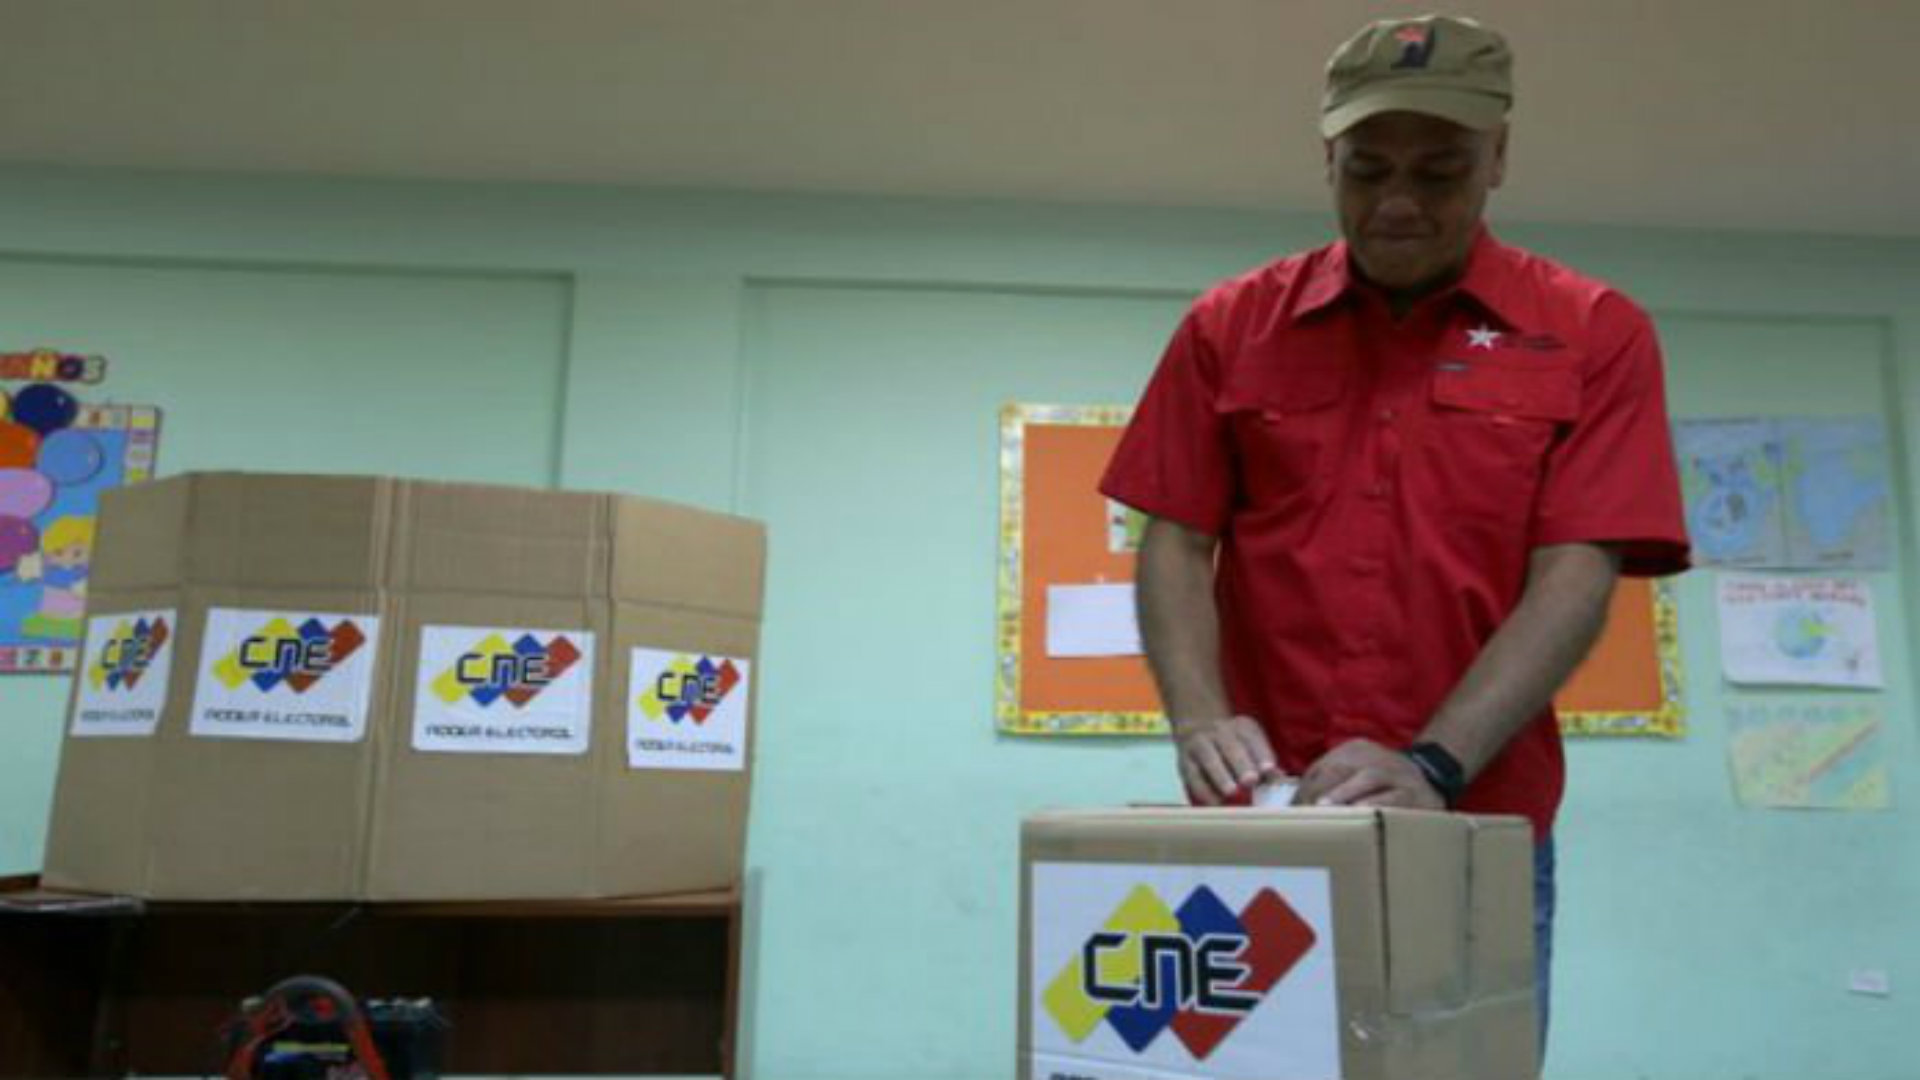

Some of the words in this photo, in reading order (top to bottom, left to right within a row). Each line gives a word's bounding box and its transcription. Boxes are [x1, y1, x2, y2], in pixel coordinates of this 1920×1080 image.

[240, 636, 334, 672] CNE
[456, 653, 551, 686] CNE
[656, 671, 720, 704] CNE
[1083, 932, 1267, 1012] CNE
